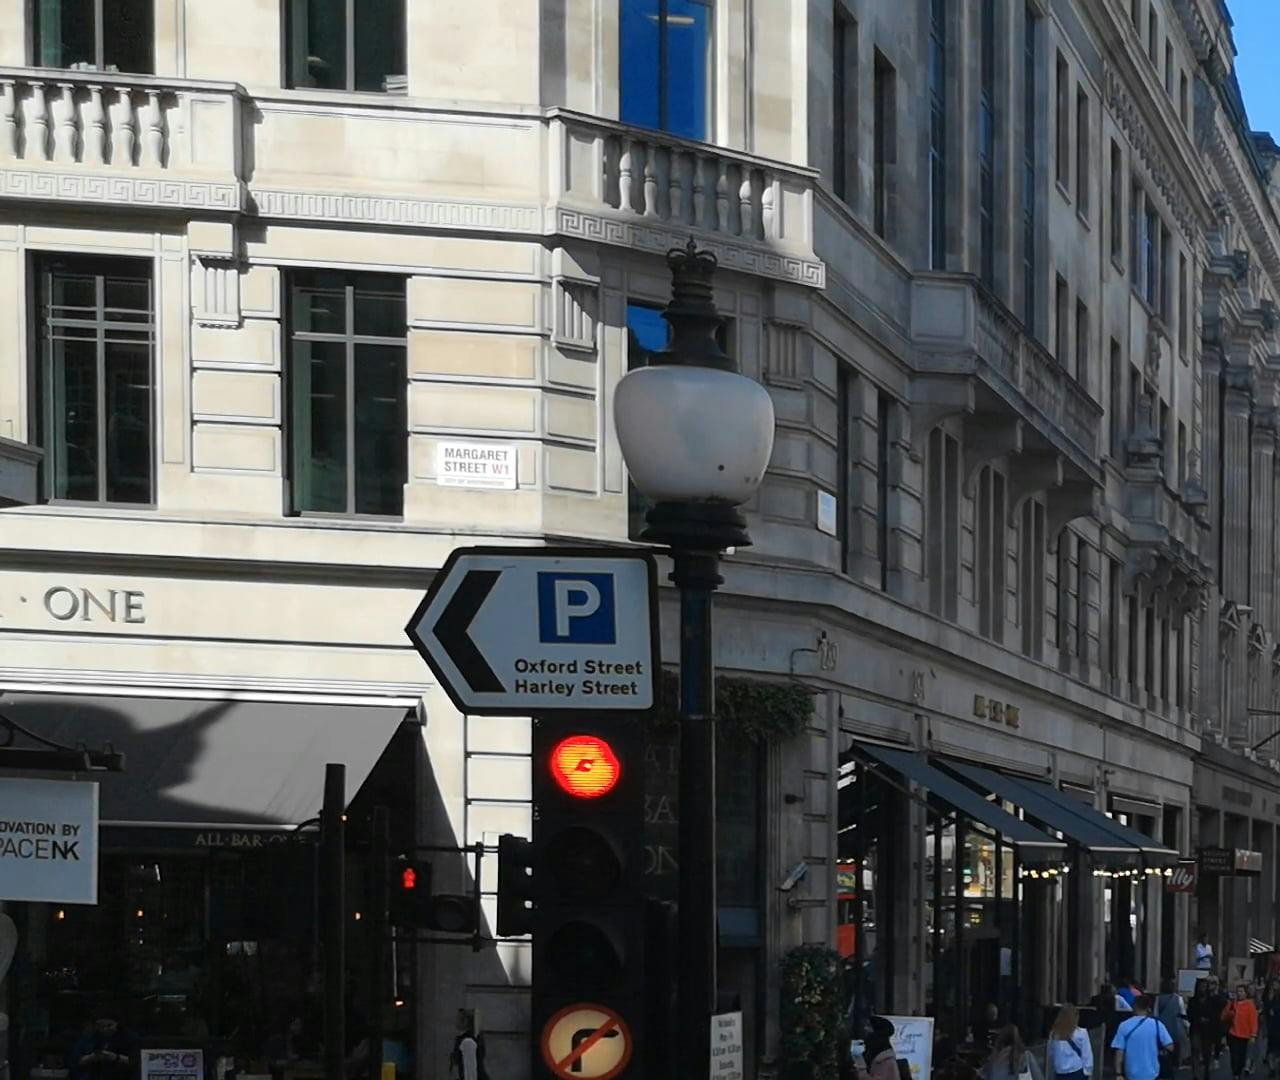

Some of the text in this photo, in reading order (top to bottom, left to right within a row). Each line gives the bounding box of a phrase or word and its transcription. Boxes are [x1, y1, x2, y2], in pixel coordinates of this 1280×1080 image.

[444, 447, 509, 461] MARGARET
[444, 461, 509, 474] STREET W1
[43, 585, 146, 624] ONE
[554, 579, 601, 637] P
[514, 658, 643, 674] Oxford Street
[515, 679, 638, 697] Harley Street
[63, 823, 80, 836] BY
